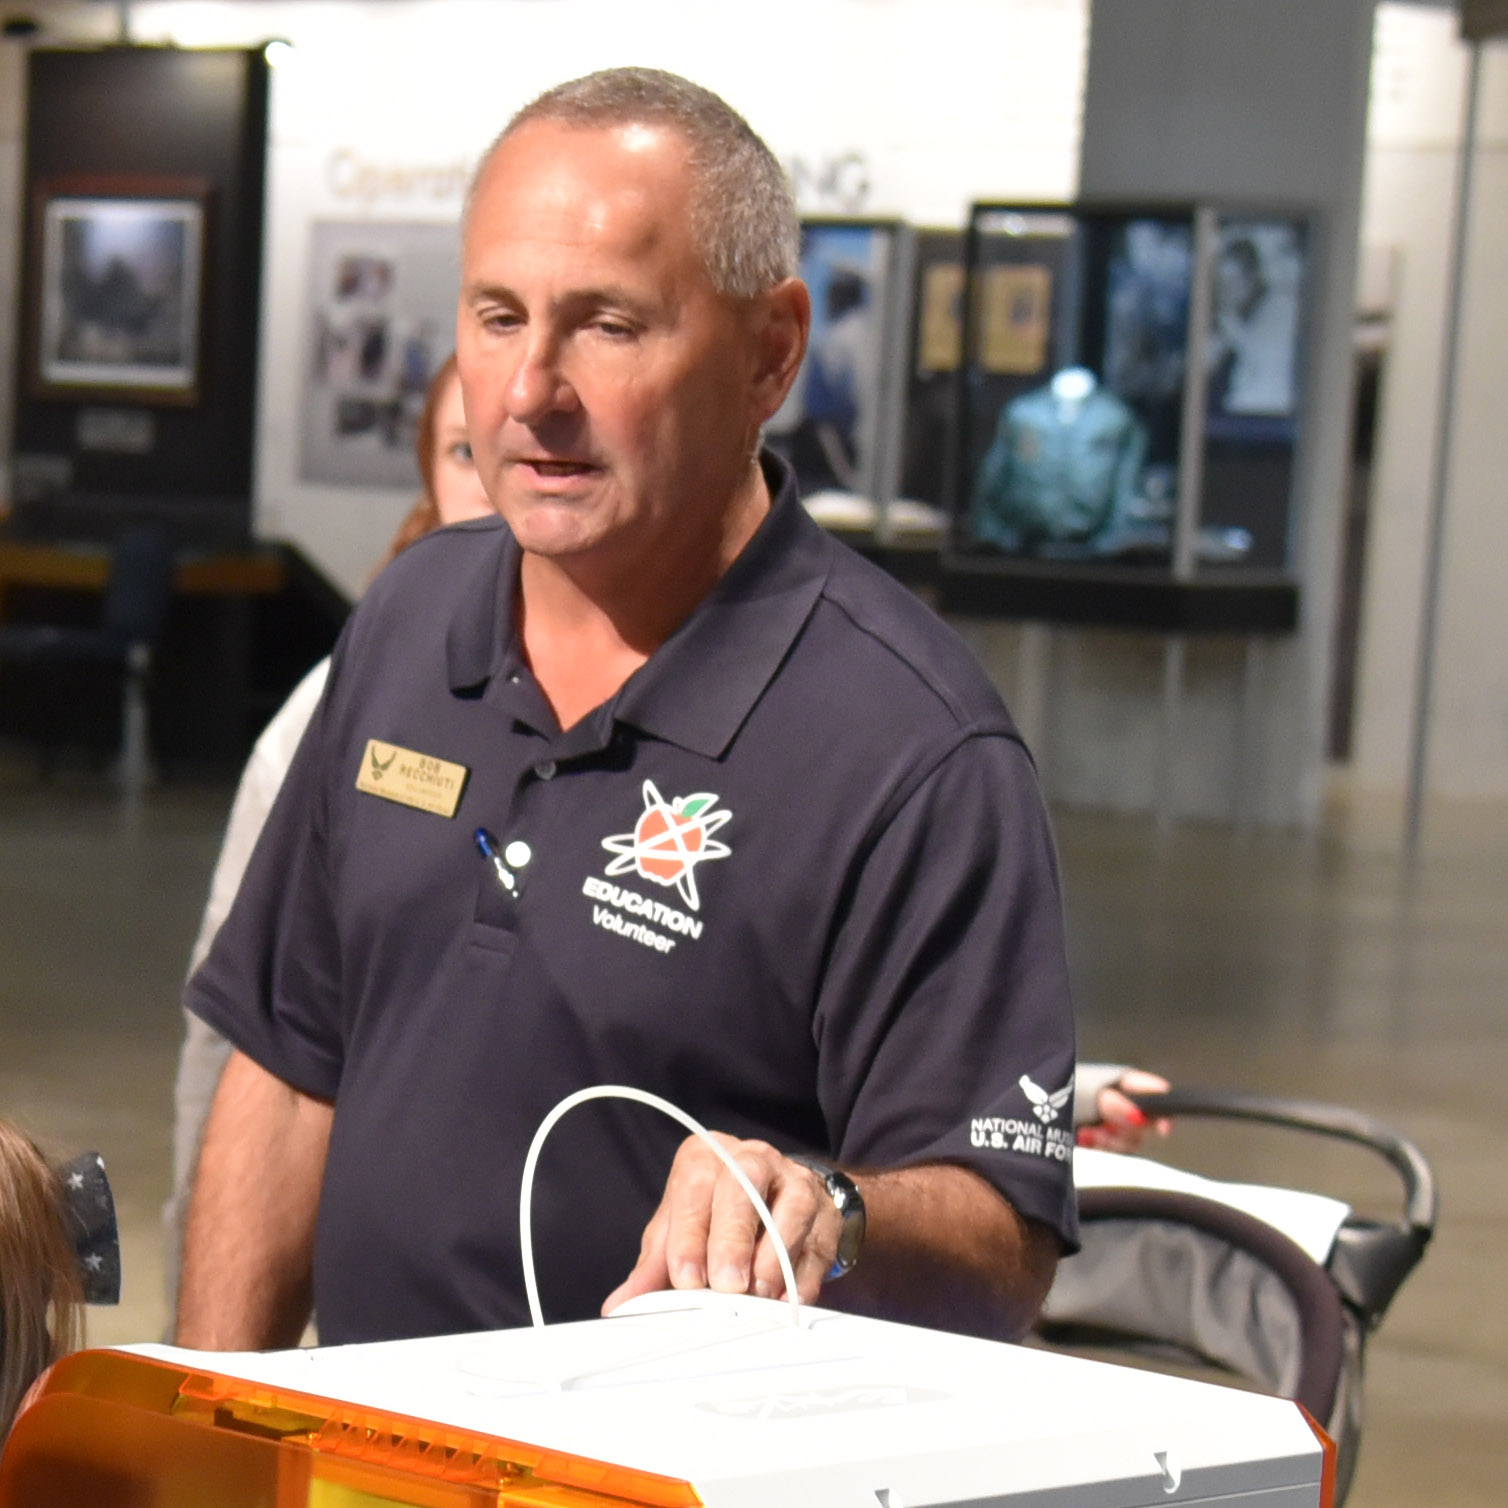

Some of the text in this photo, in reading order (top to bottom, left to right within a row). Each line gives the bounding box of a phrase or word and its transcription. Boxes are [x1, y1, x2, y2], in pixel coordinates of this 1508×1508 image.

[582, 876, 703, 940] EDUCATION
[593, 904, 676, 954] Volunteer
[970, 1117, 1044, 1140] NATIONAL
[970, 1131, 1009, 1149] U.S.
[1012, 1134, 1042, 1155] AIR
